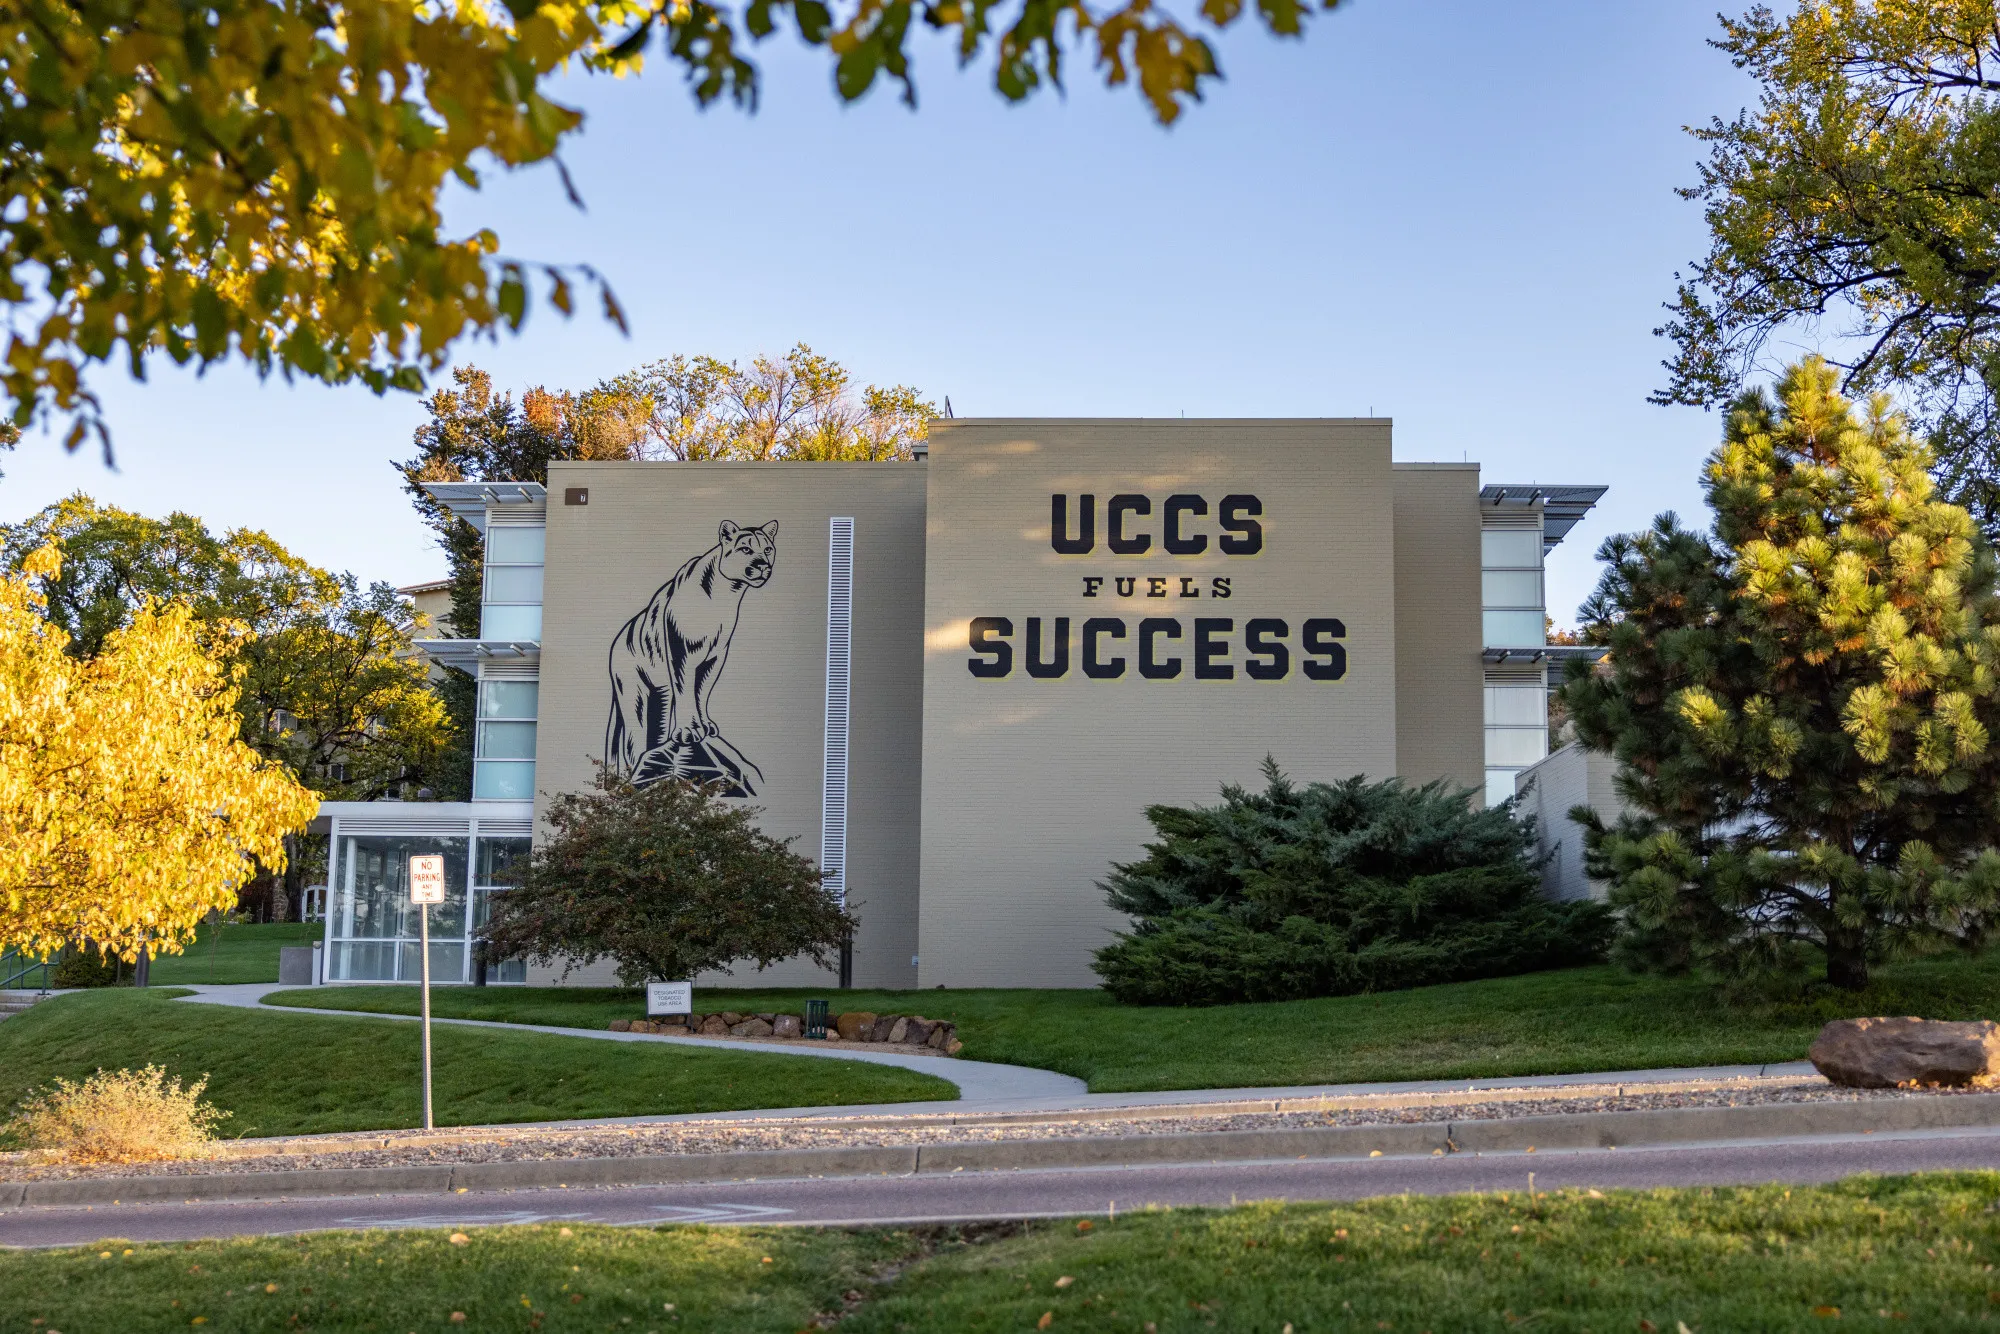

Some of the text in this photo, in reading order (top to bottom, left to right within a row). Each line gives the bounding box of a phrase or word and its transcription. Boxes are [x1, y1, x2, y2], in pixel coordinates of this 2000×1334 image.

[1051, 494, 1263, 556] UCCS
[1082, 576, 1232, 599] FUELS
[967, 616, 1347, 681] SUCCESS
[421, 861, 433, 870] NO
[413, 873, 441, 882] PARKING
